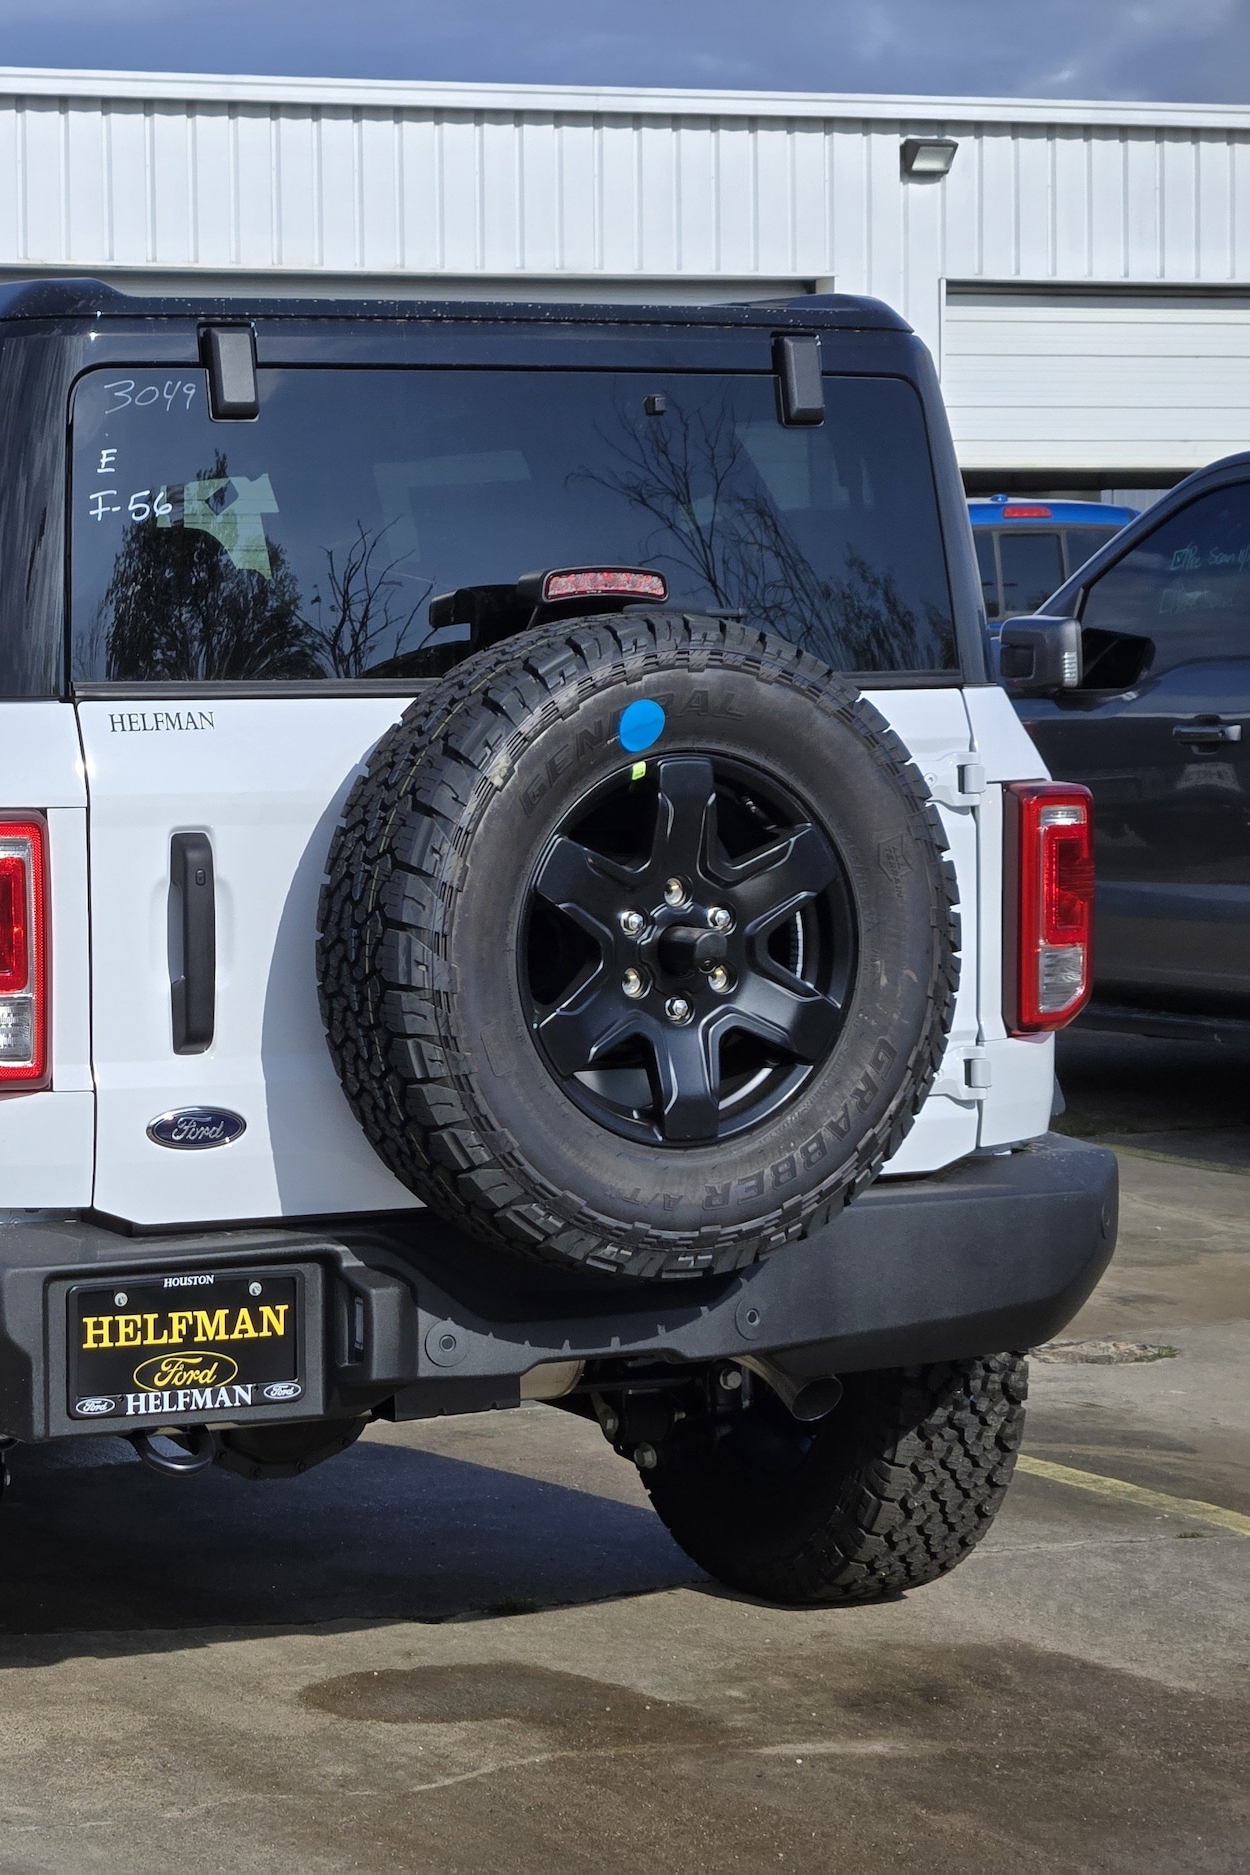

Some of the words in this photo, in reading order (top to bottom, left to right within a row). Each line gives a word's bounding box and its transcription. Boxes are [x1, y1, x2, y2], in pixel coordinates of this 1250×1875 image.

[104, 379, 196, 414] 3049
[97, 448, 118, 473] E
[108, 711, 215, 733] HELFMAN
[171, 1116, 225, 1142] Ford
[701, 1036, 898, 1212] GRABBER
[163, 1274, 215, 1289] HOUSTON
[82, 1304, 289, 1349] HELFMAN
[153, 1357, 219, 1387] Ford
[125, 1383, 254, 1416] HELFMAN
